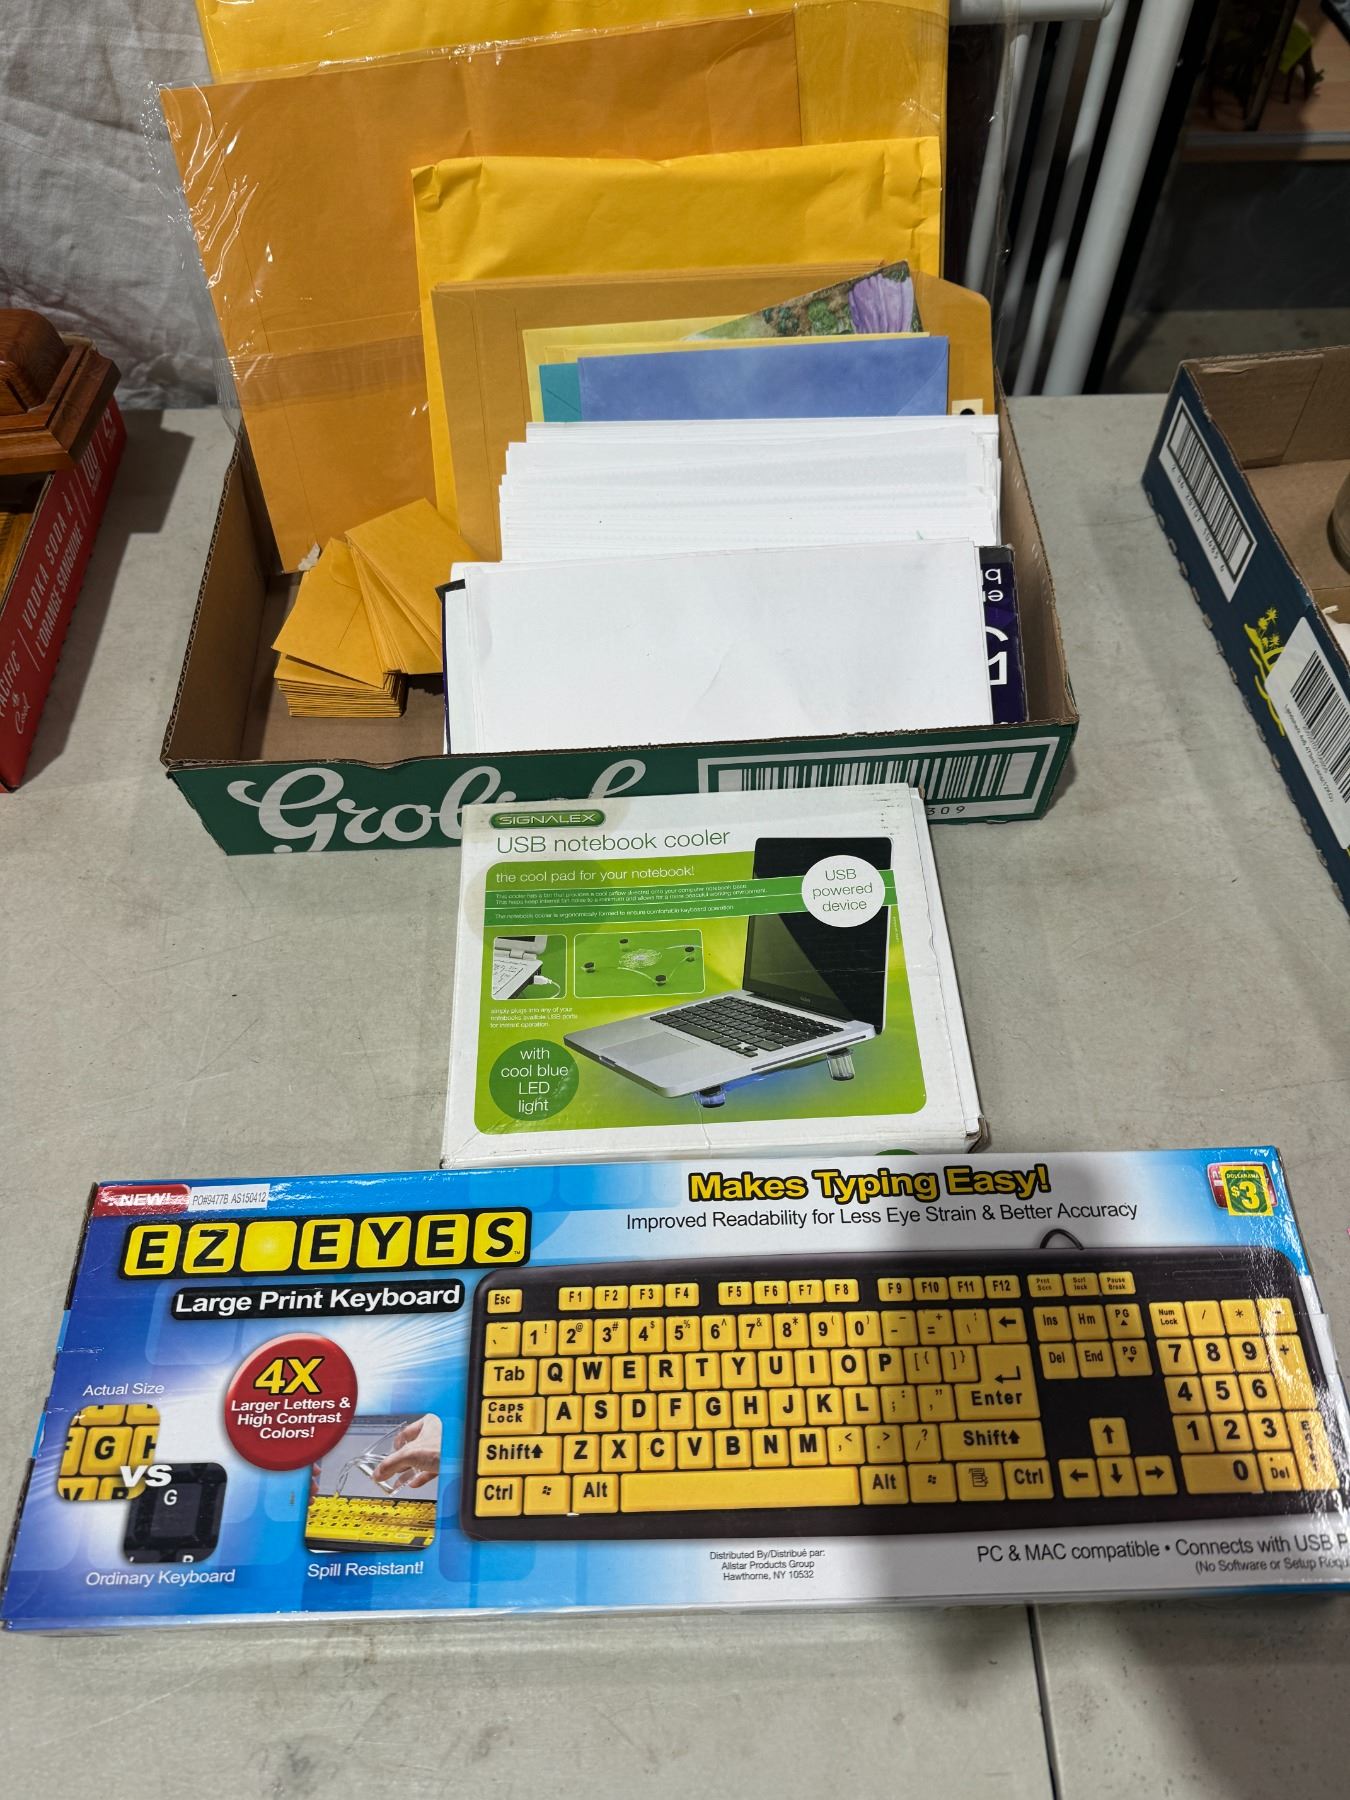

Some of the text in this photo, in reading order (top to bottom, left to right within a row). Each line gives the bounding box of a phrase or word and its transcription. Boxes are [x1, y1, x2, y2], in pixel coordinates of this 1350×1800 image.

[22, 558, 50, 630] VODKA
[46, 510, 67, 566] SODA
[499, 813, 597, 825] SIGNALEX
[497, 829, 731, 854] USB notebook cooler
[496, 866, 695, 884] the cool pad for your notebook!
[825, 868, 857, 881] USB
[812, 882, 873, 900] powered
[822, 899, 867, 912] device
[520, 1047, 550, 1060] with
[501, 1063, 569, 1078] cool blue
[518, 1081, 550, 1095] LED
[518, 1098, 549, 1115] light
[688, 1163, 1052, 1205] Makes Typing Easy!
[231, 1191, 267, 1205] AS150412
[1231, 1181, 1260, 1209] $3
[626, 1202, 1137, 1233] Improved Readability for Less Eye Strain & Better Accuracy
[309, 1217, 514, 1263] EYES
[175, 1285, 461, 1317] Large Print Keyboard
[494, 1279, 1011, 1305] Esc F10 F11 F12
[1042, 1314, 1058, 1327] Ins
[1158, 1308, 1175, 1316] Num
[1160, 1318, 1178, 1326] Lock
[1048, 1350, 1104, 1364] Del End
[1167, 1341, 1258, 1363] 7 8 9
[253, 1355, 325, 1395] 4X
[493, 1353, 892, 1383] Tab Q W E R T Y U I O P
[82, 1382, 165, 1397] Actual Size
[1177, 1378, 1268, 1402] 4 5 6
[231, 1397, 351, 1413] Larger Letters &
[488, 1401, 525, 1413] Caps
[555, 1390, 1023, 1421] A S D F G H J K L Enter
[237, 1412, 342, 1427] High Contrast
[487, 1411, 523, 1424] Lock
[259, 1426, 315, 1440] Colors!
[1187, 1417, 1278, 1442] 1 2 3
[94, 1436, 116, 1460] G
[486, 1429, 1009, 1461] Shift Z X C V B N M Shift
[1232, 1459, 1249, 1481] 0
[1270, 1466, 1290, 1479] Del
[483, 1468, 1044, 1501] Ctrl Alt Alt Ctrl
[163, 1489, 178, 1506] G
[709, 1548, 826, 1561] Distributed By/Distribué par:
[977, 1533, 1333, 1563] PC & MAC compatible Connects with USB
[307, 1561, 424, 1580] Spill Resistant!
[721, 1559, 815, 1570] Allstar Products Group
[1195, 1560, 1216, 1575] (No
[1218, 1559, 1268, 1572] Software
[1270, 1560, 1281, 1571] or
[1283, 1557, 1317, 1572] Setup
[86, 1569, 235, 1588] Ordinary Keyboard
[723, 1570, 815, 1581] Hawthorne, NY 10532
